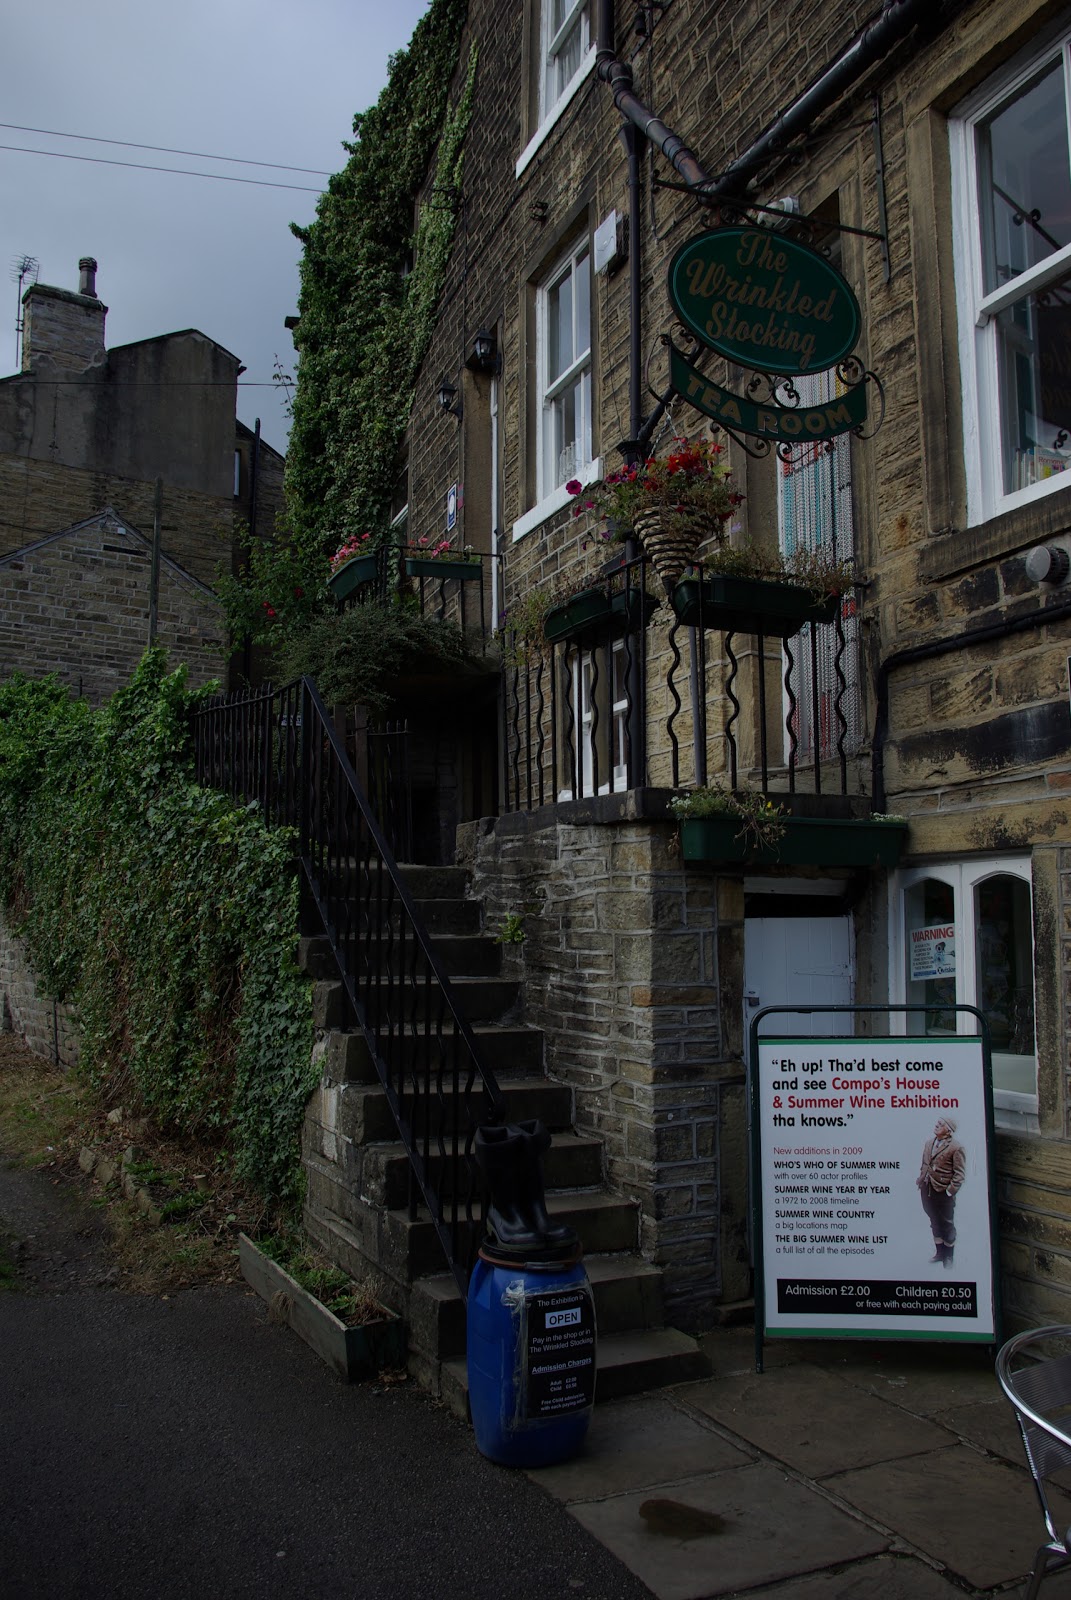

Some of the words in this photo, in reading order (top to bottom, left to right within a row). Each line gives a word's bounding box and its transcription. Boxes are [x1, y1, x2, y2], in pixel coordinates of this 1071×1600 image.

[735, 230, 790, 273] The
[686, 258, 837, 323] Wrinkled
[705, 301, 817, 371] Stocking
[686, 373, 743, 425] TEA
[757, 403, 853, 435] ROOM
[911, 926, 954, 943] WARNING
[801, 1059, 823, 1075] up!
[871, 1059, 901, 1072] best
[905, 1061, 943, 1071] come
[772, 1077, 798, 1090] and
[803, 1079, 827, 1090] see
[896, 1077, 940, 1090] House
[772, 1096, 783, 1108] &
[788, 1095, 845, 1108] Summer
[849, 1095, 885, 1108] Wine
[890, 1095, 959, 1108] Exhibition
[772, 1114, 795, 1127] tha
[773, 1147, 792, 1155] New
[793, 1147, 830, 1155] additions
[832, 1147, 840, 1155] in
[842, 1147, 863, 1155] 2009
[803, 1161, 824, 1169] WHO
[826, 1161, 838, 1169] OF
[840, 1161, 876, 1169] SUMMER
[878, 1161, 900, 1169] WINE
[774, 1172, 789, 1180] with
[808, 1172, 819, 1180] 60
[820, 1172, 839, 1180] actor
[841, 1172, 868, 1181] profiles
[774, 1185, 809, 1193] SUMMER
[811, 1185, 833, 1193] WINE
[835, 1185, 855, 1193] YEAR
[870, 1186, 890, 1194] YEAR
[782, 1196, 798, 1204] 1972
[809, 1196, 828, 1204] 2008
[830, 1197, 860, 1205] timeline
[775, 1210, 810, 1218] SUMMER
[812, 1210, 834, 1218] WINE
[836, 1210, 875, 1219] COUNTRY
[782, 1221, 794, 1230] big
[795, 1221, 829, 1229] locations
[830, 1223, 848, 1231] map
[775, 1234, 790, 1243] THE
[793, 1234, 807, 1243] BIG
[809, 1234, 845, 1243] SUMMER
[847, 1235, 869, 1243] WINE
[872, 1235, 888, 1244] LIST
[782, 1246, 794, 1254] full
[795, 1246, 805, 1254] list
[807, 1246, 815, 1254] of
[815, 1246, 825, 1254] all
[826, 1246, 839, 1254] the
[840, 1246, 875, 1256] episodes
[784, 1284, 837, 1296] Admission
[840, 1285, 871, 1296] £2.00
[895, 1285, 939, 1298] Children
[941, 1286, 971, 1299] £0.50
[537, 1299, 549, 1307] The
[551, 1296, 577, 1306] Exhibition
[855, 1300, 865, 1309] or
[865, 1299, 882, 1309] free
[882, 1299, 900, 1309] with
[901, 1300, 922, 1310] each
[923, 1302, 950, 1312] paying
[951, 1301, 972, 1311] adult
[549, 1312, 577, 1325] OPEN
[533, 1336, 545, 1345] Pay
[553, 1333, 562, 1341] the
[563, 1331, 578, 1340] shop
[529, 1345, 542, 1354] The
[532, 1362, 566, 1374] Admission
[568, 1357, 592, 1368] Charges
